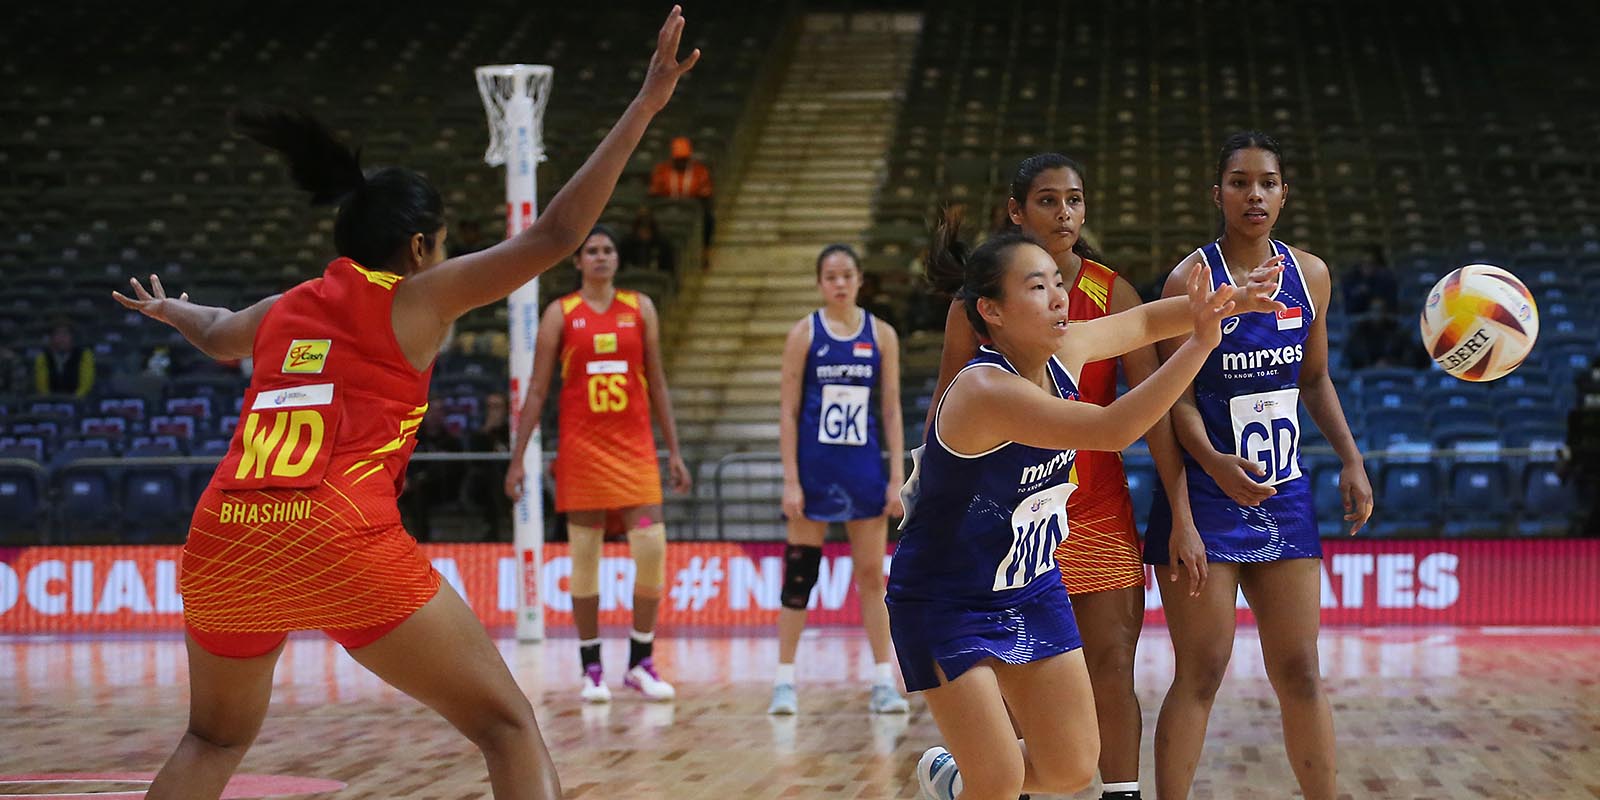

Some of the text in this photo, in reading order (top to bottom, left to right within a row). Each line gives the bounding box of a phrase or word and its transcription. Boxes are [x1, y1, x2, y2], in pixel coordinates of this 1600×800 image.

[1223, 344, 1303, 371] mirxes
[588, 374, 628, 413] GS
[825, 404, 861, 441] GK
[235, 409, 325, 479] WD
[1241, 418, 1297, 484] GD
[220, 500, 311, 523] BHASHINI
